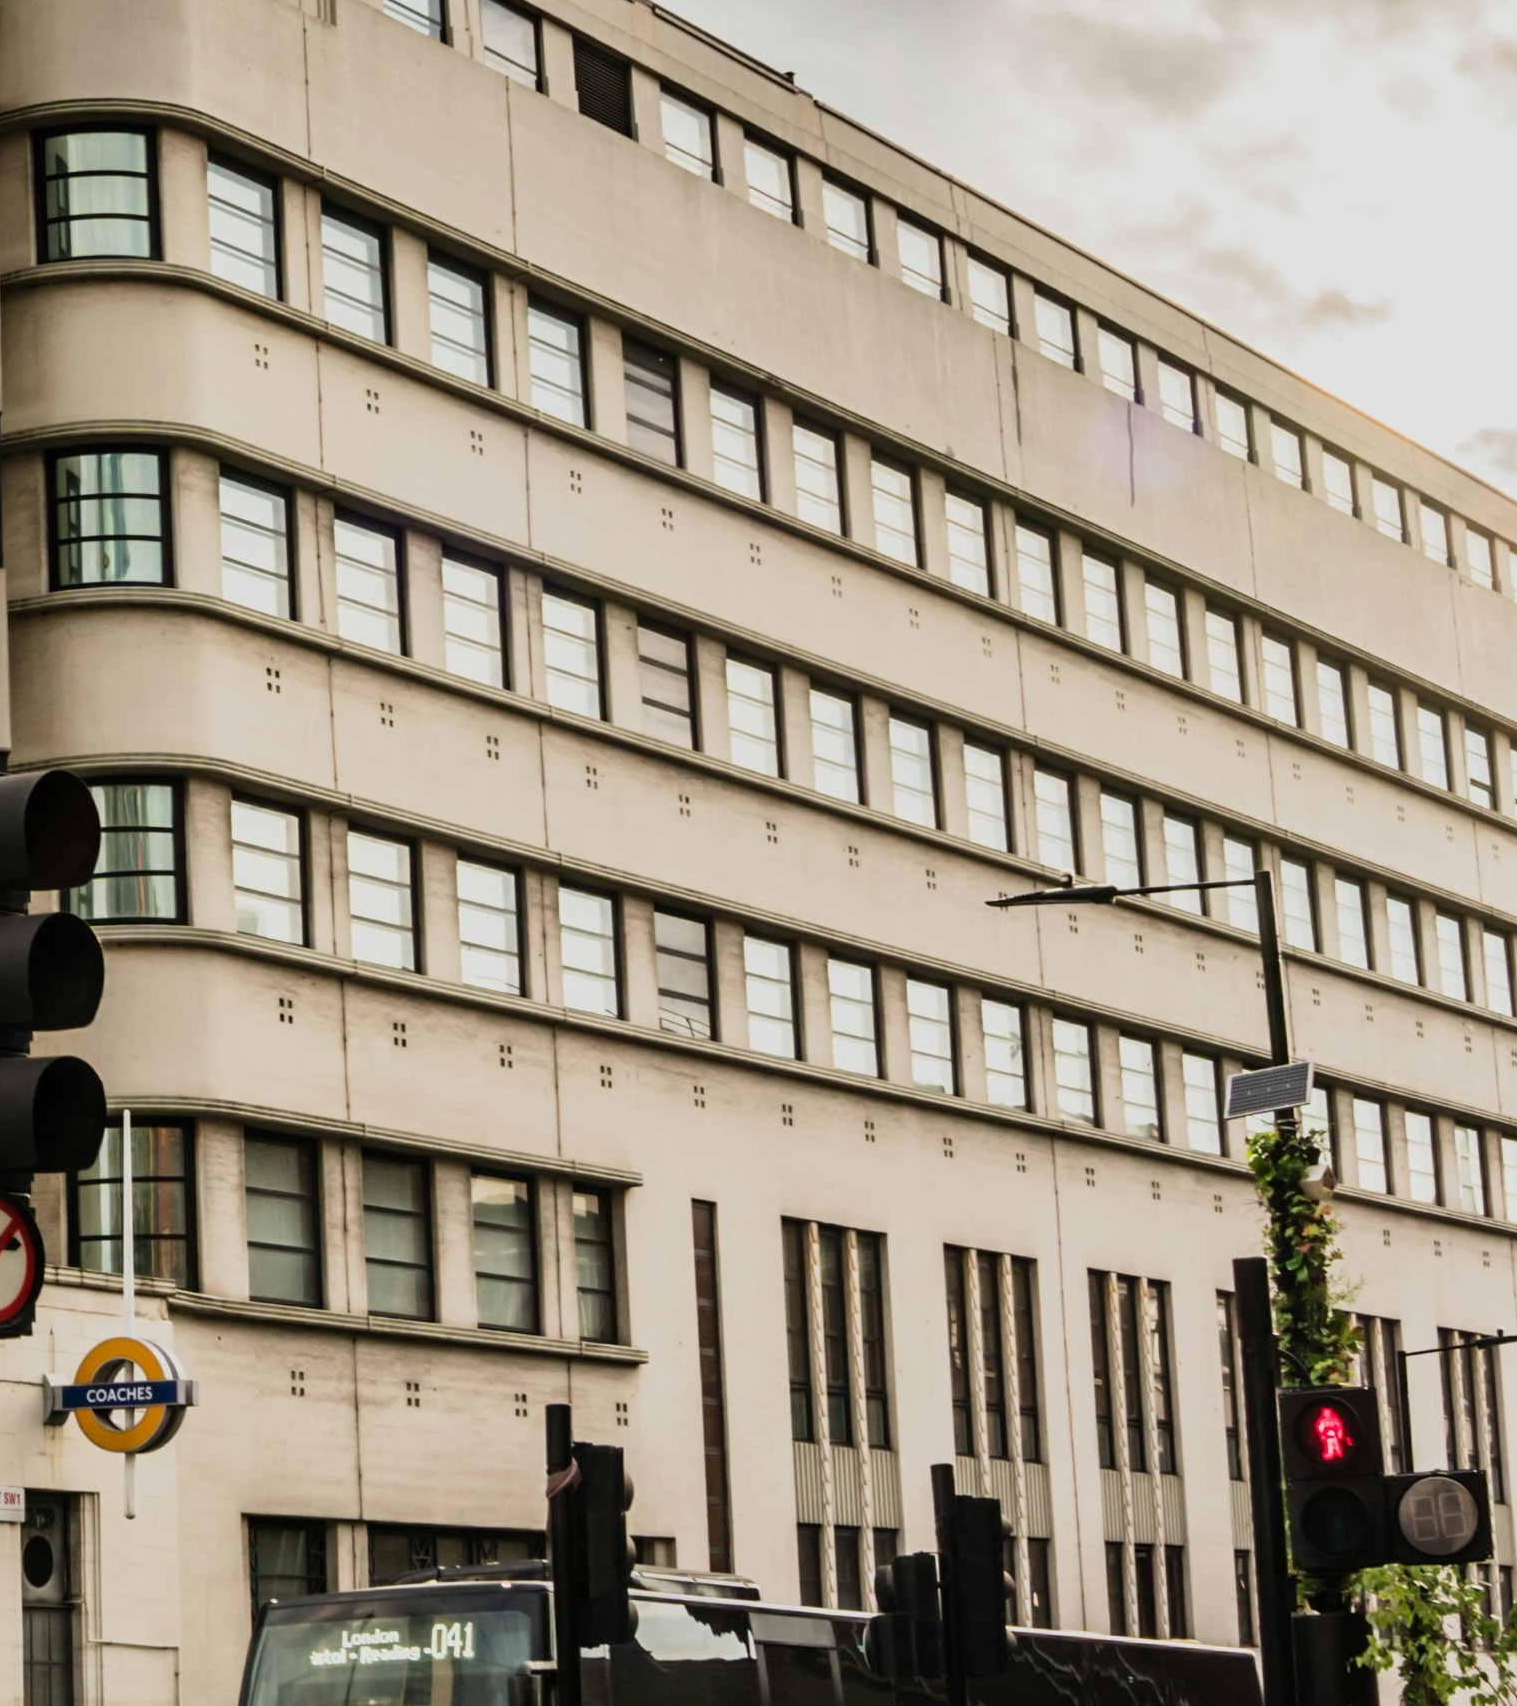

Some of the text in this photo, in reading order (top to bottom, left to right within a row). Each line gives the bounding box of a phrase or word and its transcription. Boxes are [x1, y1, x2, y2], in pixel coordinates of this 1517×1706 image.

[85, 1385, 153, 1403] COACHES
[3, 1491, 20, 1505] SW1
[342, 1628, 400, 1648] London
[431, 1621, 475, 1660] 041
